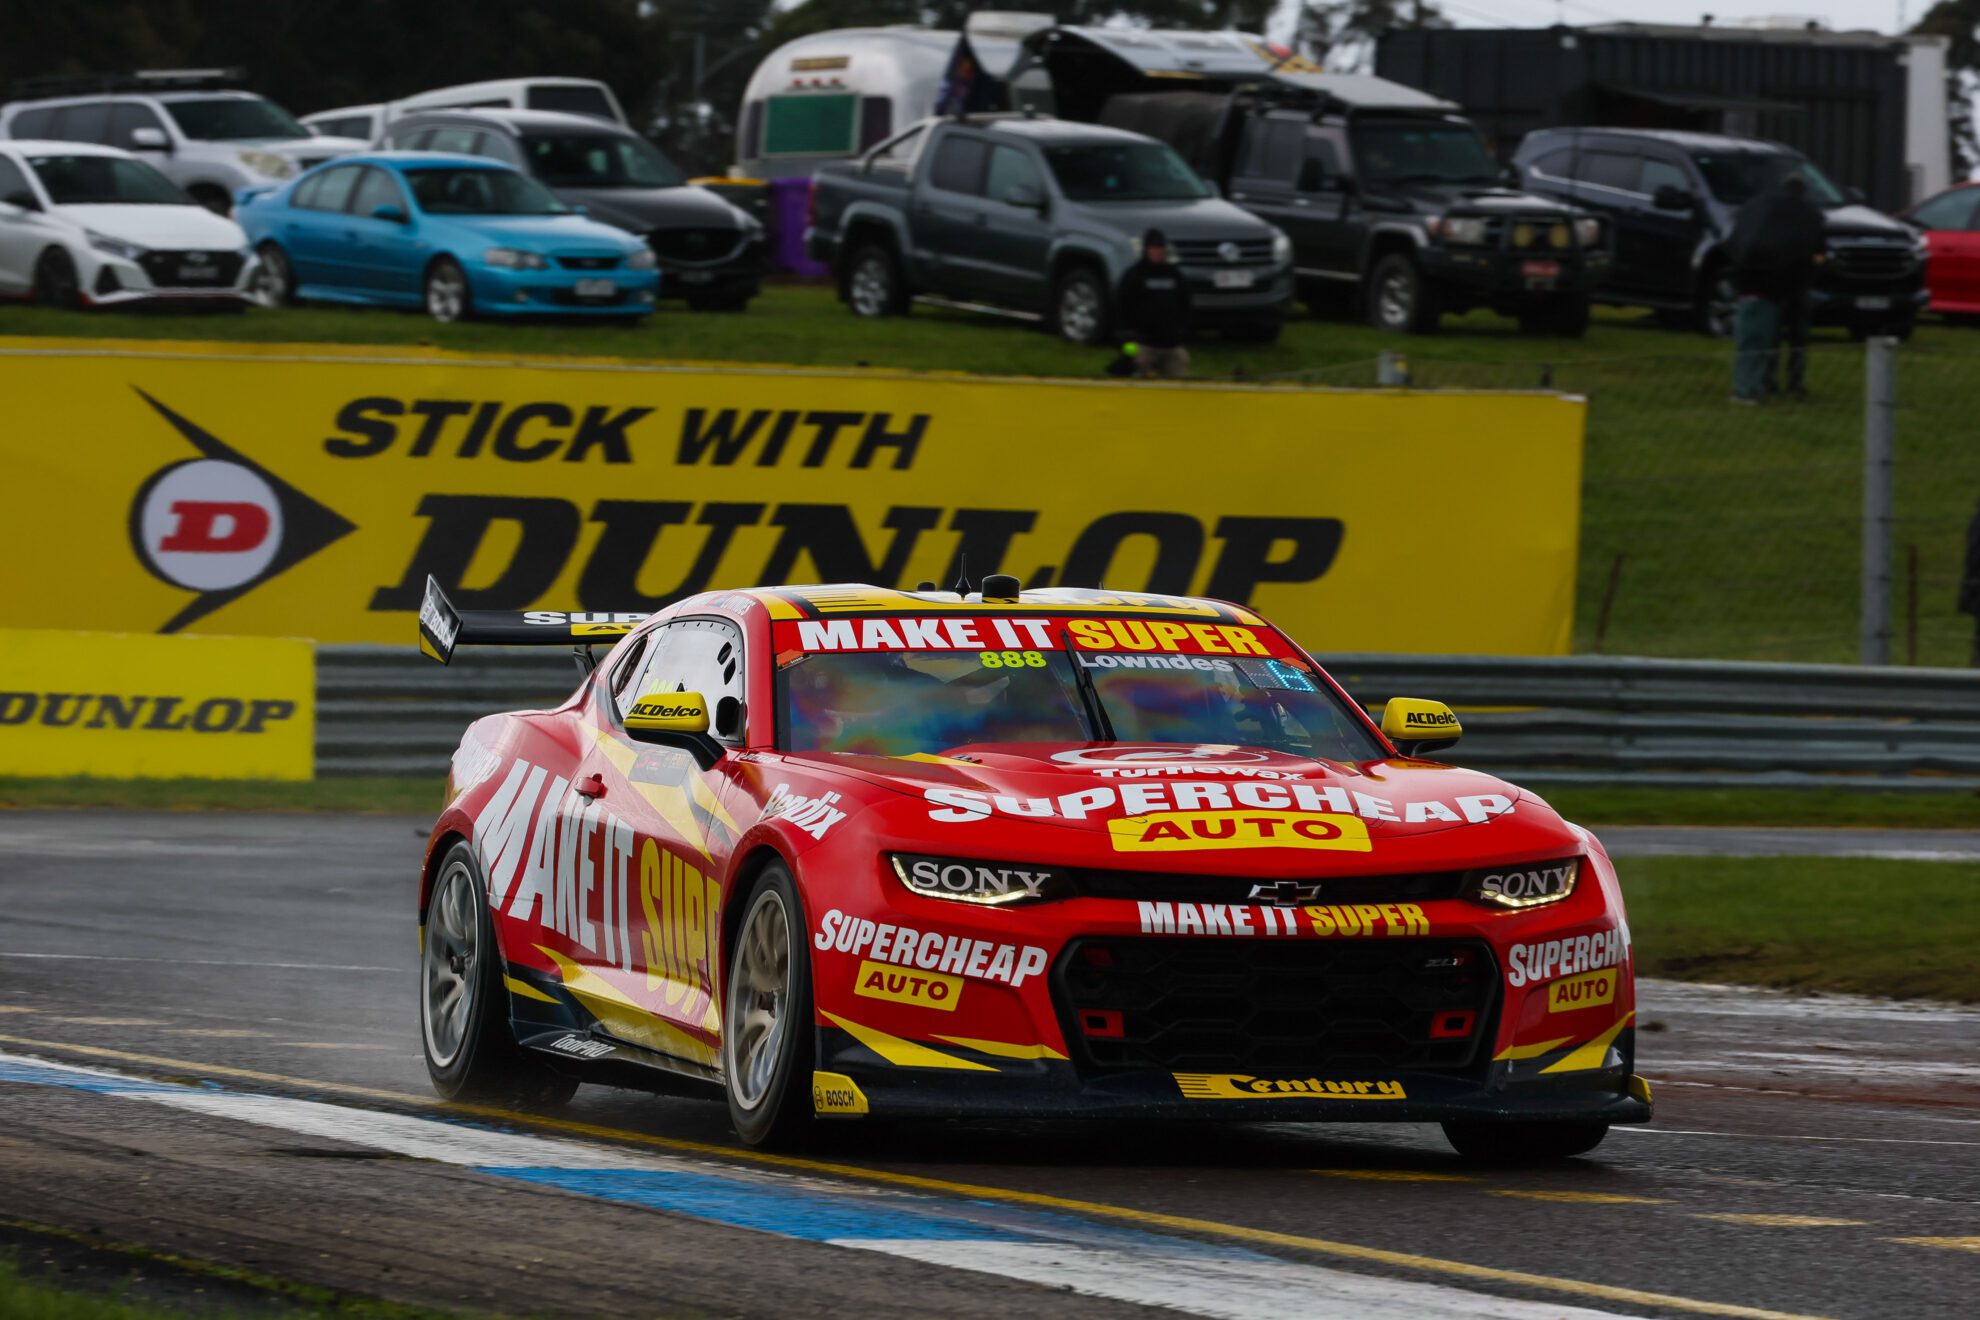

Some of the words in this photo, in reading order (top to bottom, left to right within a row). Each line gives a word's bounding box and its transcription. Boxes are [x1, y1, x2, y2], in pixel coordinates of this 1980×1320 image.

[322, 396, 656, 464] STICK
[675, 408, 932, 470] WITH
[158, 500, 271, 553] D
[366, 494, 1344, 611] DUNLOP
[796, 618, 986, 651] MAKE
[992, 618, 1055, 649] IT
[1067, 619, 1272, 655] SUPER
[979, 650, 1047, 669] 888
[1076, 651, 1234, 673] Lowndes
[0, 691, 297, 734] DUNLOP
[628, 703, 702, 718] ACDelco
[924, 782, 1516, 825] SUPERCHEAP
[1139, 816, 1343, 843] AUTO
[472, 757, 603, 954] MAKE
[603, 812, 635, 975] IT
[911, 861, 1051, 898] SONY
[1480, 866, 1572, 900] SONY
[1137, 900, 1255, 936] MAKE
[1259, 904, 1298, 936] IT
[1304, 903, 1430, 936] SUPER
[814, 908, 1048, 988] SUPERCHEAP
[1508, 922, 1629, 988] SUPERCH
[863, 970, 949, 1001] AUTO
[1555, 977, 1609, 1004] AUTO
[825, 1089, 855, 1107] BOSCH
[1224, 1074, 1407, 1098] Century
